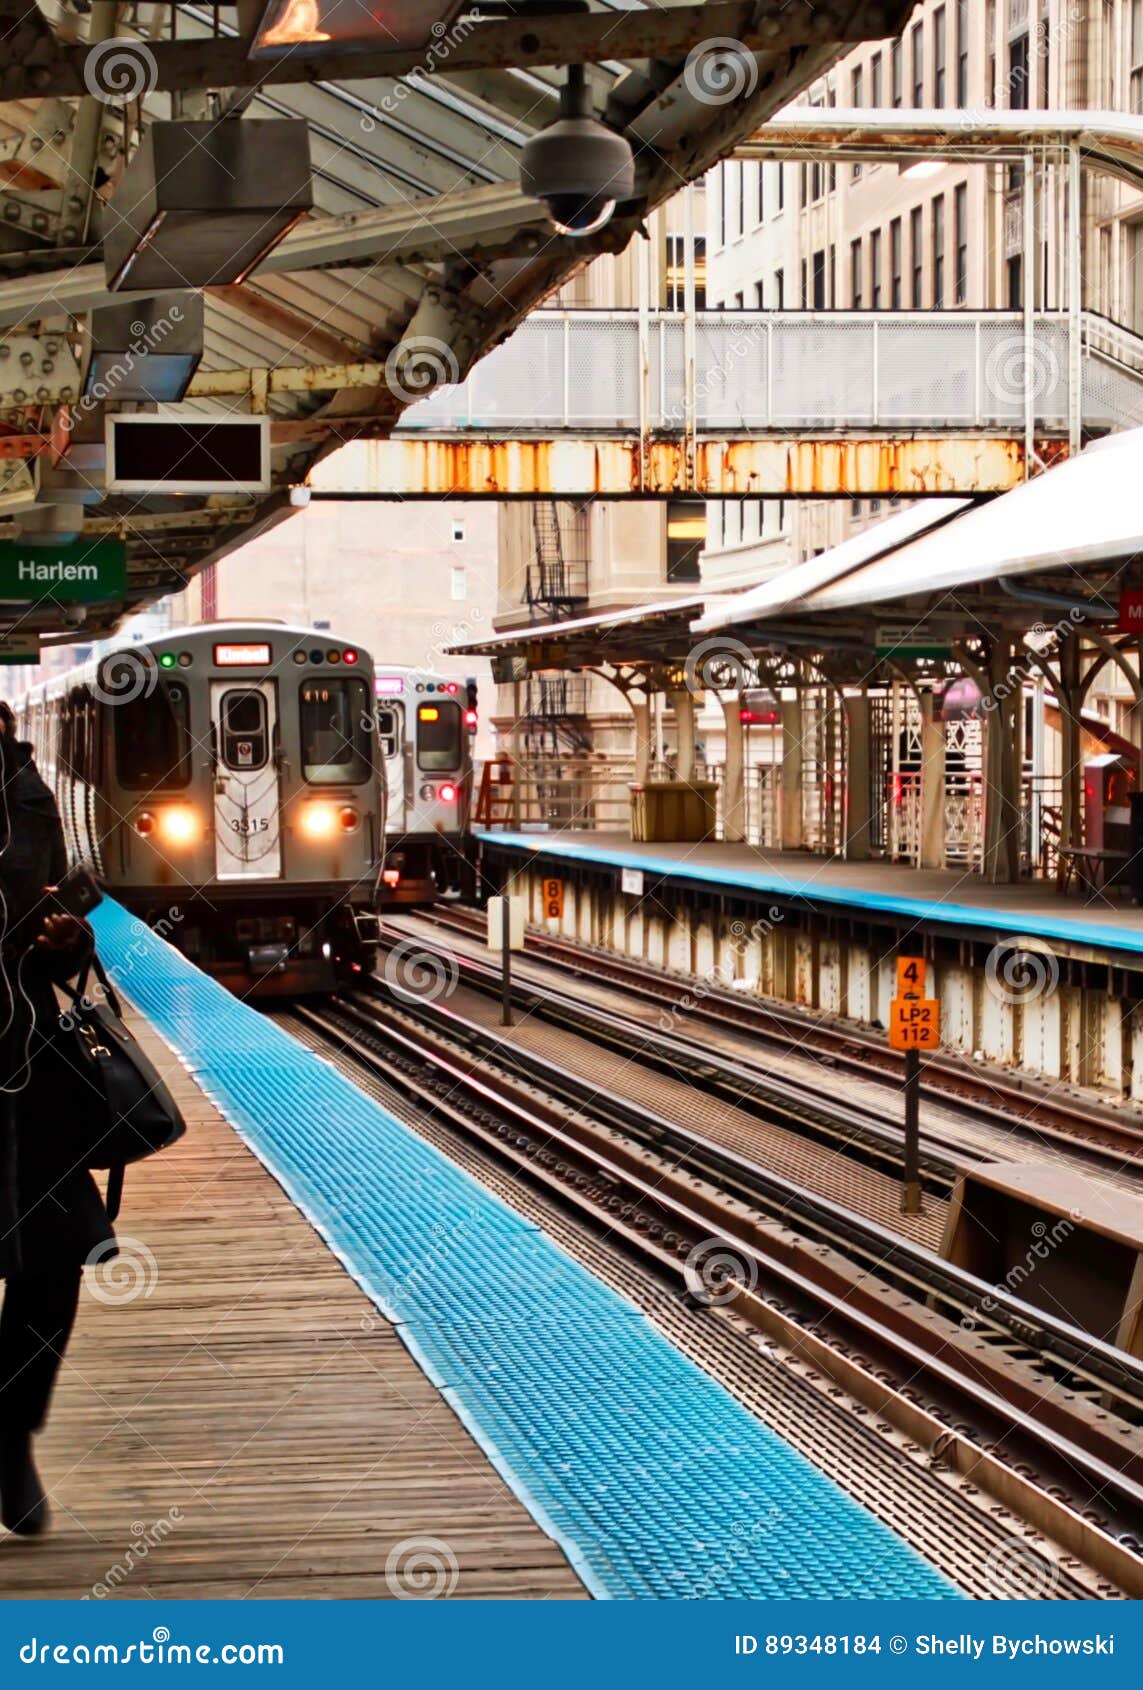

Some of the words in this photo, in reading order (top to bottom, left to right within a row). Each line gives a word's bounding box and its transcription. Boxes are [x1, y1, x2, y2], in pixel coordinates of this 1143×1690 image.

[18, 560, 98, 580] Harlem
[1128, 605, 1143, 618] M
[548, 881, 558, 898] 8
[548, 900, 559, 917] 6
[903, 962, 918, 983] 4
[899, 1008, 930, 1022] LP2
[902, 1028, 930, 1041] 112
